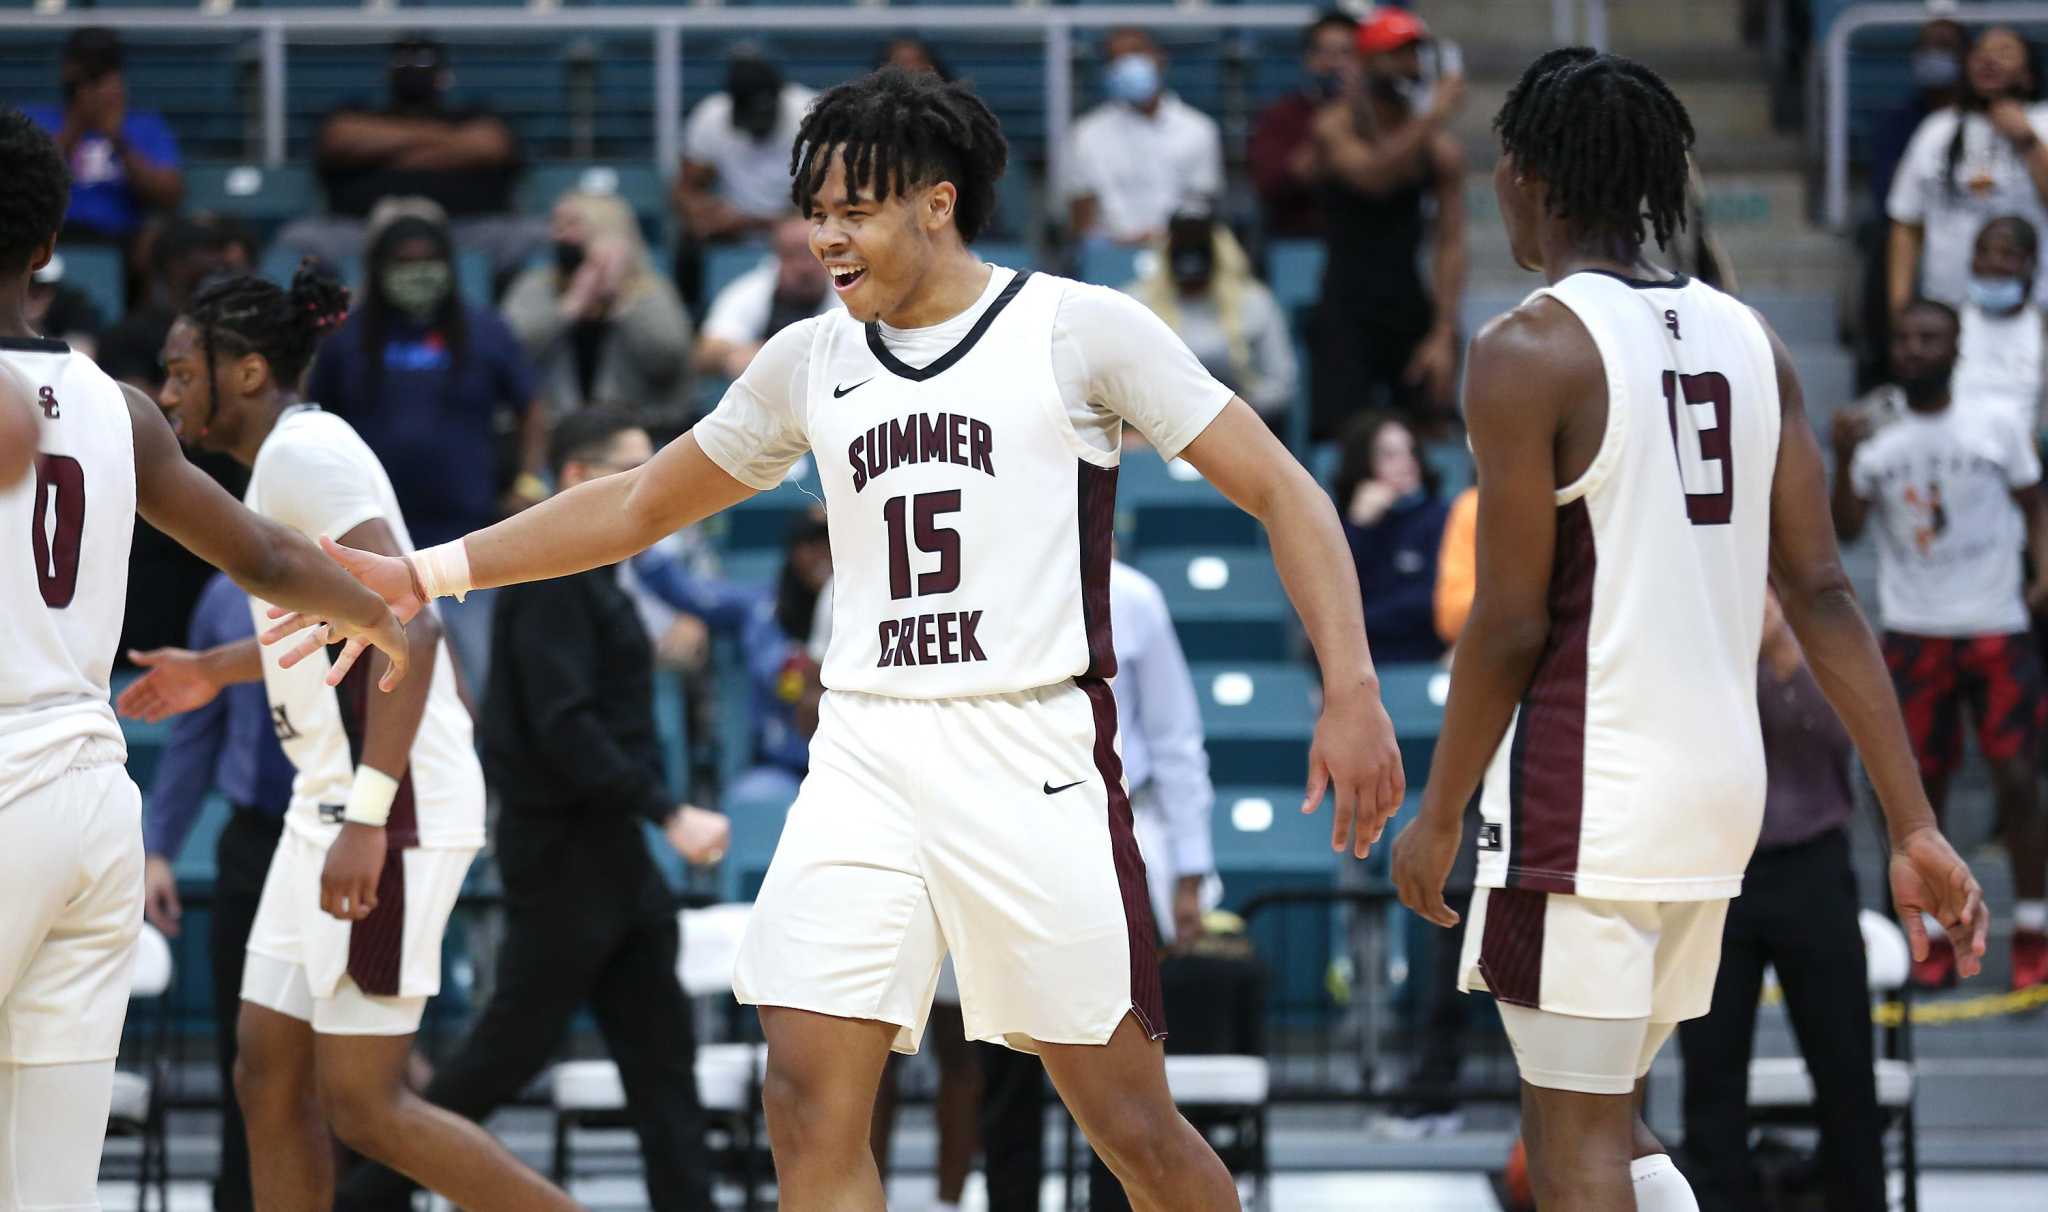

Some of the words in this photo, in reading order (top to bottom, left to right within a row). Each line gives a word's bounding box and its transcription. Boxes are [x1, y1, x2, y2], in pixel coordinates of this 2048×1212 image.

[848, 412, 996, 493] SUMMER
[1662, 369, 1733, 525] 13
[32, 452, 86, 609] 0
[883, 489, 961, 600] 15
[877, 610, 988, 668] CREEK
